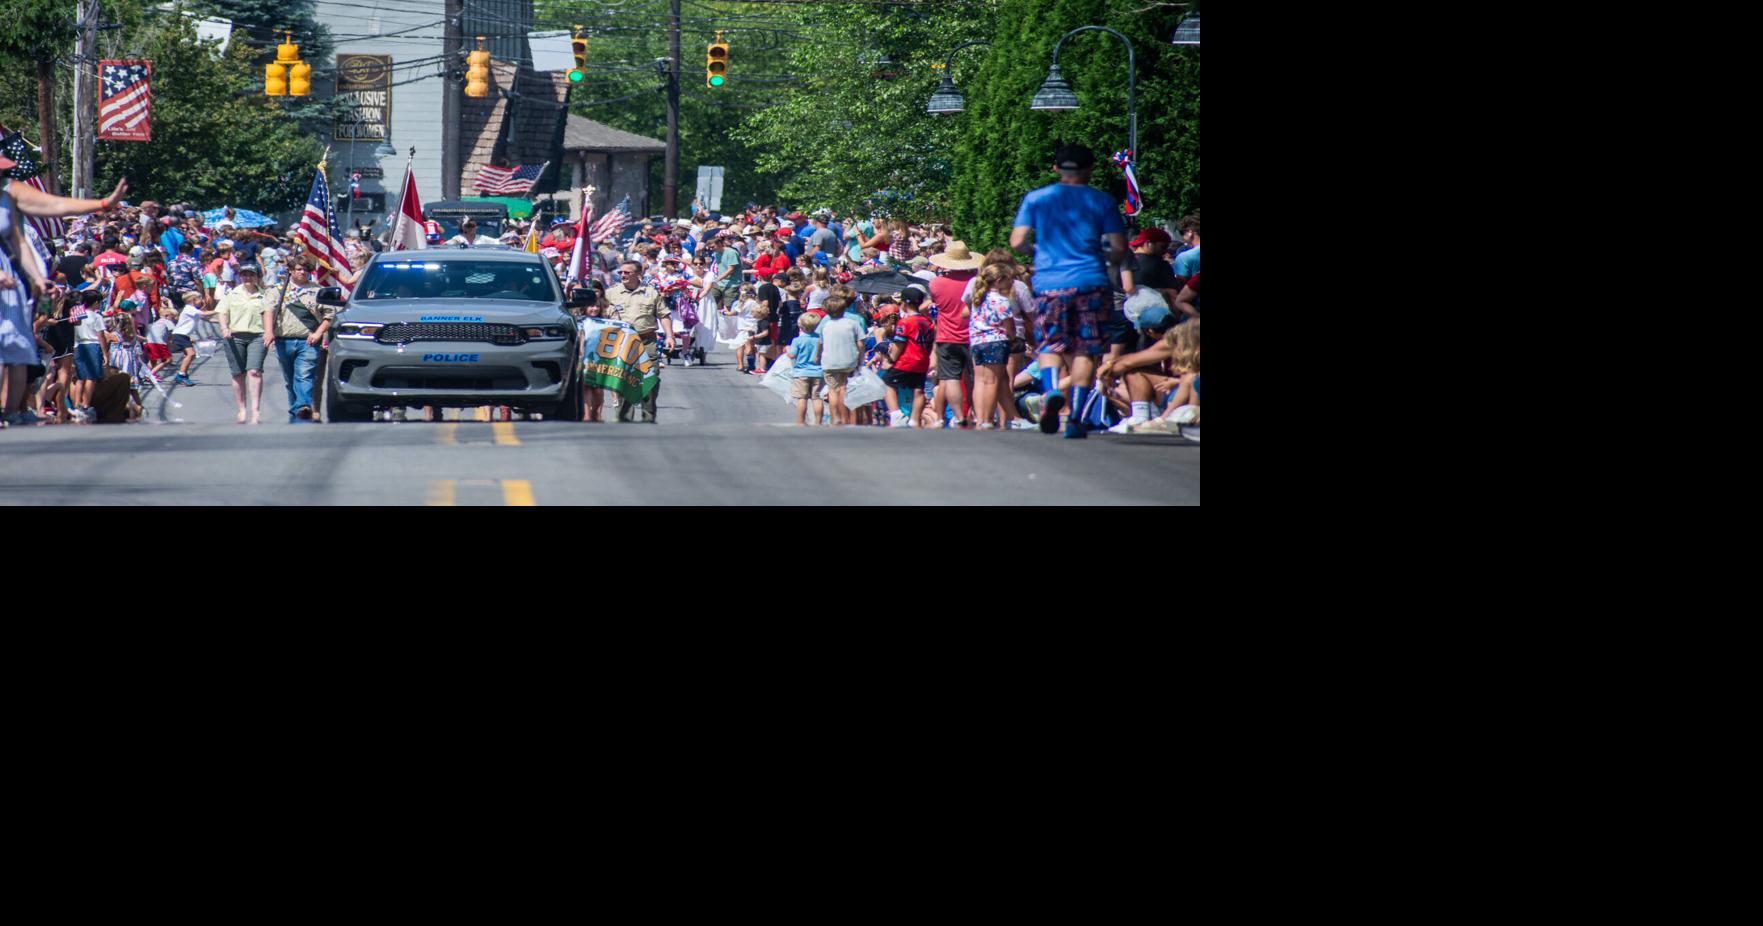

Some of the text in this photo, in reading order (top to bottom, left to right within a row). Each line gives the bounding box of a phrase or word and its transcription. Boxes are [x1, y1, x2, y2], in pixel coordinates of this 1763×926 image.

[341, 91, 386, 106] CLUSIVE
[354, 124, 385, 138] WOMEN
[423, 353, 480, 362] POLICE
